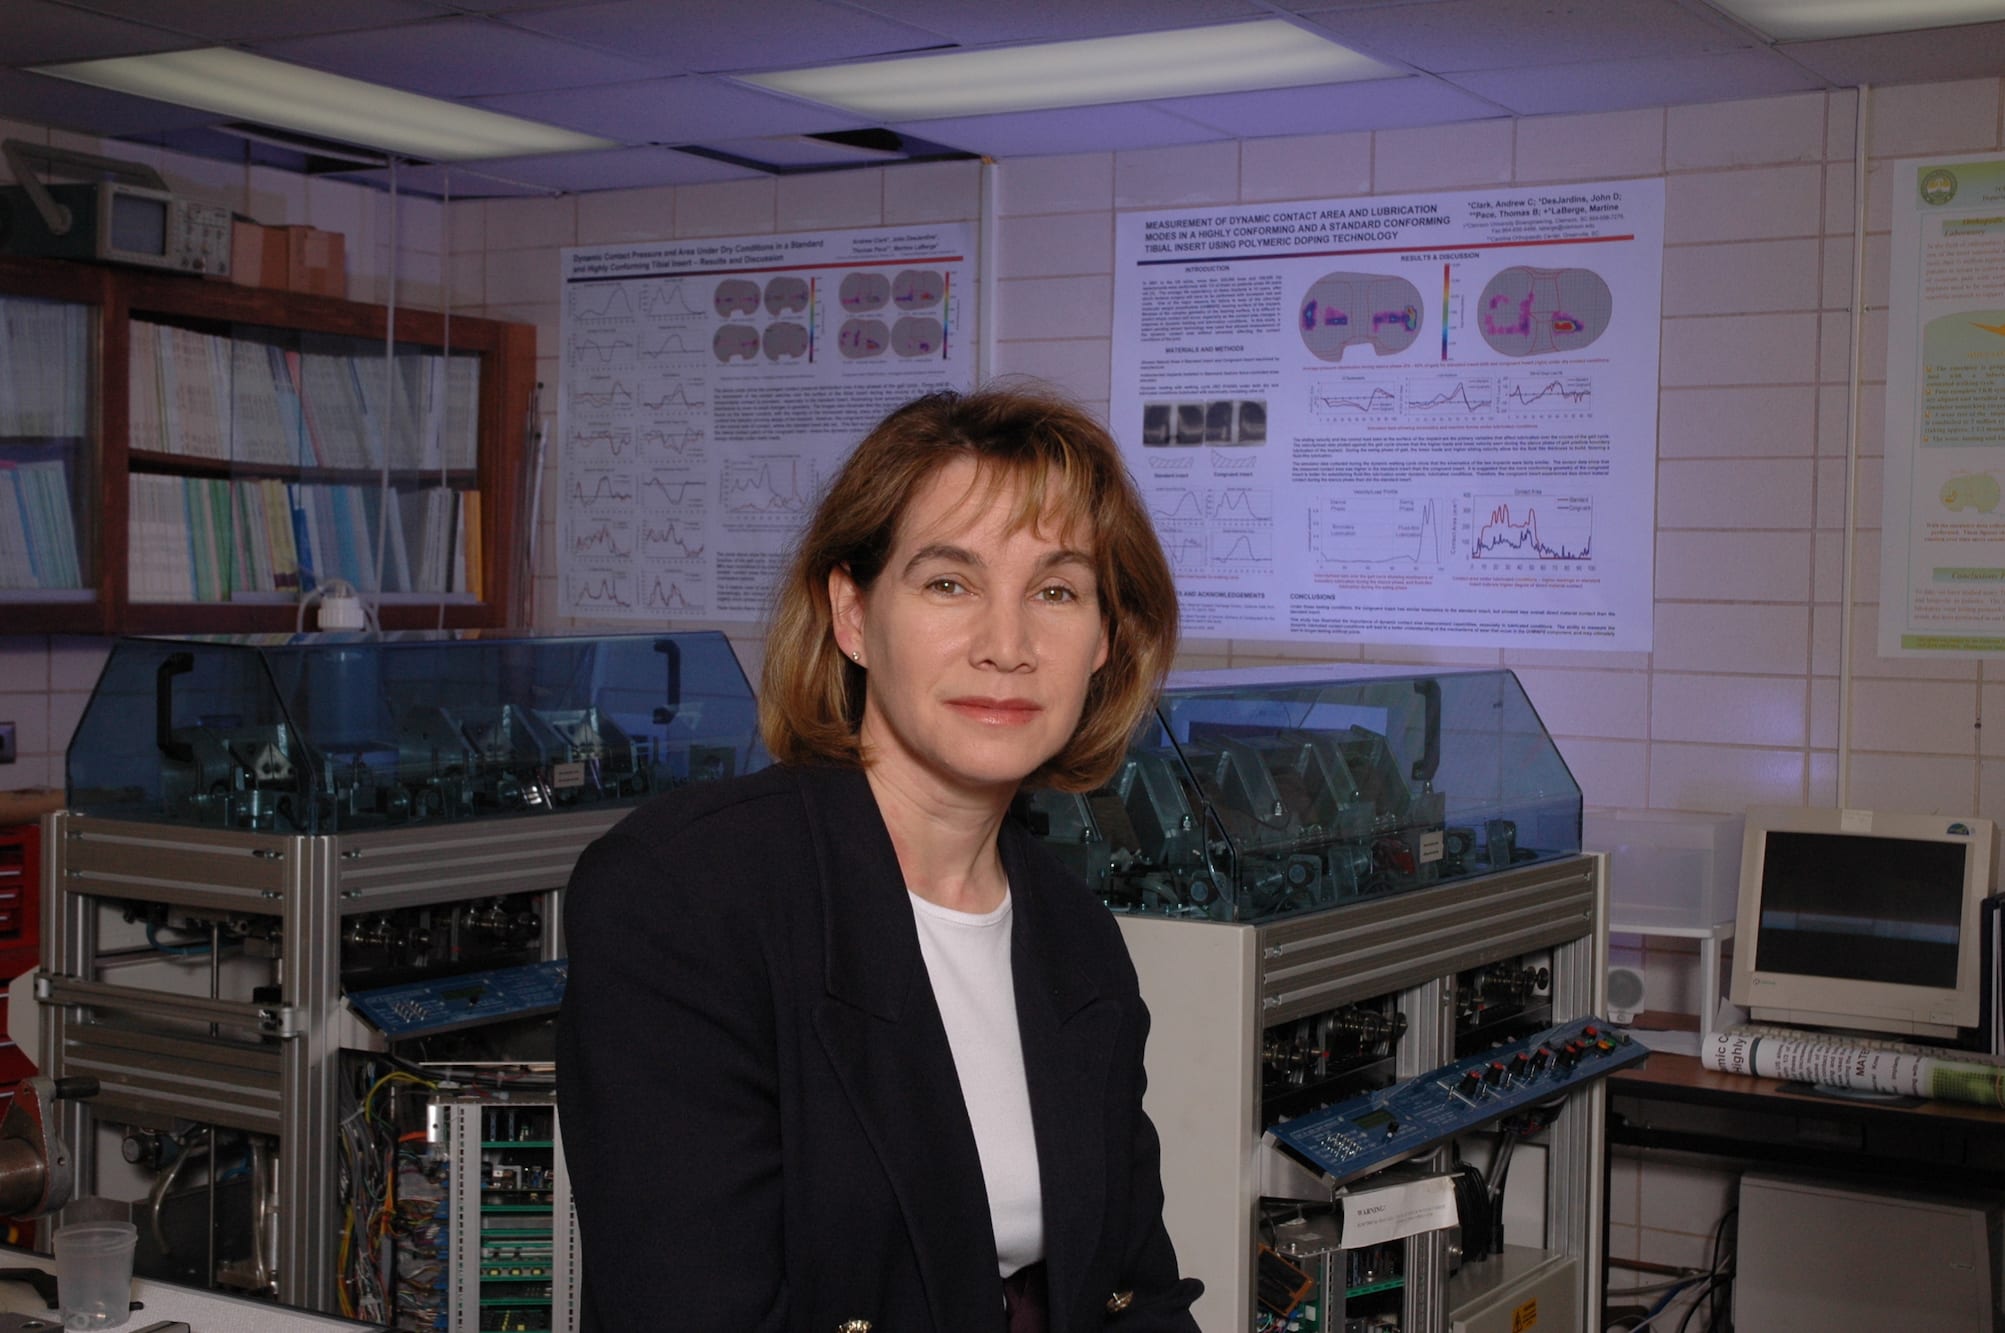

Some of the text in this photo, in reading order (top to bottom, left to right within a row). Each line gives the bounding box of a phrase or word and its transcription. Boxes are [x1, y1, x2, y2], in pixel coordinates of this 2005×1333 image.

[1496, 199, 1525, 208] Andrew
[1590, 194, 1610, 202] John
[1146, 204, 1437, 230] MEASUREMENT OF DYNAMIC CONTACT AREA AND LUBRICATION
[1500, 209, 1529, 218] Thomas
[1589, 203, 1619, 212] Martine
[1145, 216, 1450, 242] MODES IN A HIGHLY CONFORMING AND A STANDARD CONFORMING
[697, 246, 718, 255] Under
[721, 246, 733, 255] Dry
[791, 240, 824, 249] Standard
[1144, 230, 1398, 253] TIBIAL INSERT USING POLYMERIC DOPING TECHNOLOGY
[1439, 252, 1480, 260] DISCUSSION
[1185, 265, 1230, 273] INTRODUCTION
[1290, 592, 1336, 601] CONCLUSIONS
